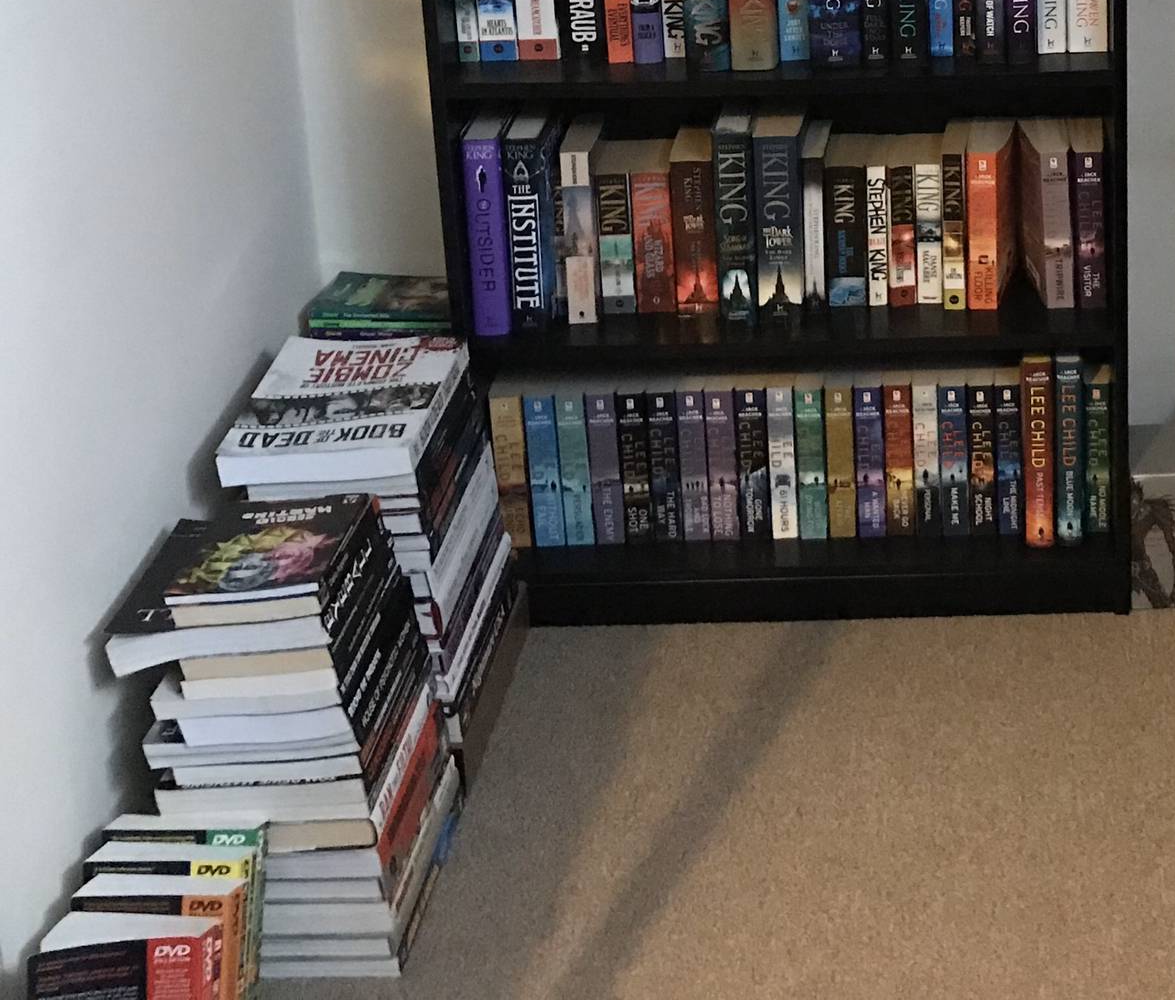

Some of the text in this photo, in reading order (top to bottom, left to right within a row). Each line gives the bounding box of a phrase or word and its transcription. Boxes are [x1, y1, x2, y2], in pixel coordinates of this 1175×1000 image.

[663, 0, 685, 39] KING
[464, 151, 494, 161] KING
[511, 184, 531, 194] THE
[718, 151, 748, 225] KING
[763, 152, 791, 221] KING
[917, 173, 939, 213] KING
[943, 167, 963, 217] KING
[600, 184, 628, 234] KING
[833, 183, 855, 224] KING
[476, 197, 497, 292] OUTSIDER
[867, 178, 888, 281] STEPHEN KING
[509, 194, 543, 310] INSTITUTE
[974, 271, 983, 302] FLOOR
[983, 266, 993, 304] KILLING
[1082, 264, 1092, 298] VISITOR
[1092, 272, 1101, 289] THE
[309, 361, 413, 383] ZOMBIE
[315, 344, 421, 367] CINEMA
[238, 429, 315, 448] DEAD
[333, 423, 407, 442] BOOK
[739, 422, 753, 470] CHILD
[752, 429, 764, 459] LEE
[982, 429, 992, 459] LEE
[1030, 385, 1046, 492] LEE CHILD PAST
[1061, 384, 1077, 489] LEE CHILD BLUE
[650, 429, 665, 480] CHILD
[664, 436, 676, 466] LEE
[628, 506, 639, 533] SHOT
[638, 509, 649, 530] ONE
[666, 490, 677, 539] THE HARD
[781, 499, 789, 532] HOURS
[951, 487, 960, 526] MAKE ME
[210, 834, 246, 846] DVD
[196, 864, 231, 876] DVD
[189, 901, 223, 912] DVD
[153, 944, 191, 958] DVD
